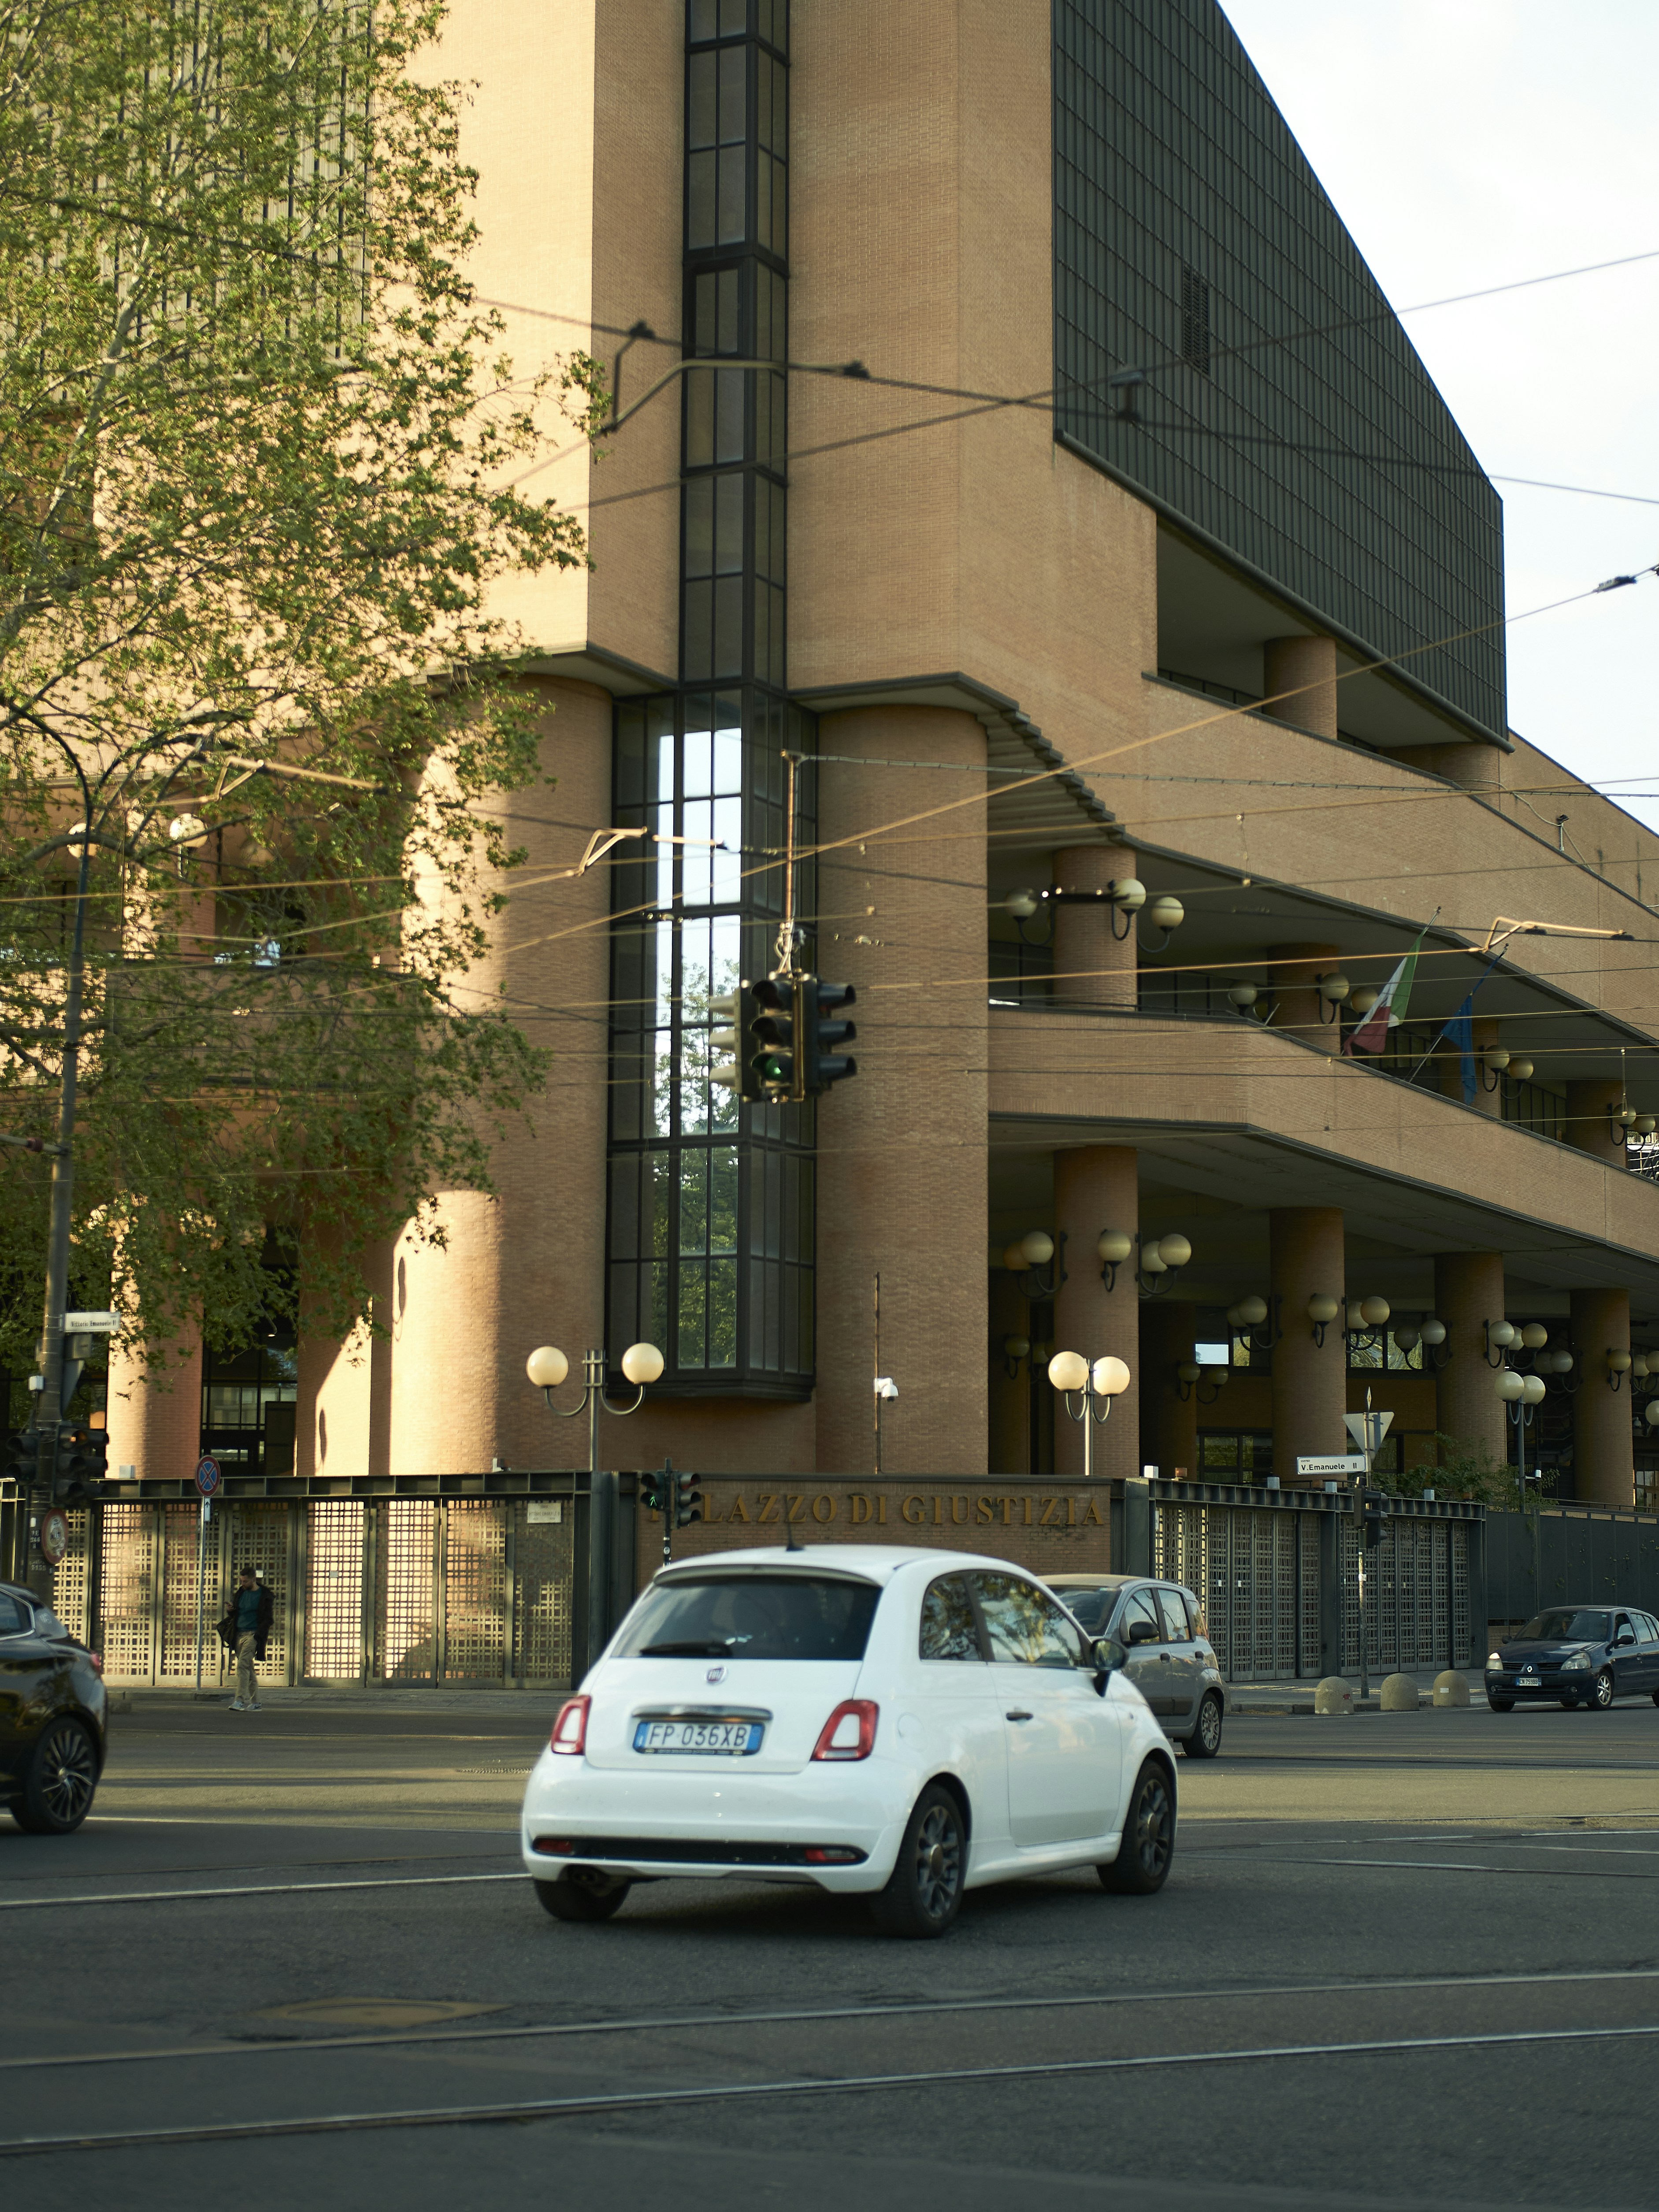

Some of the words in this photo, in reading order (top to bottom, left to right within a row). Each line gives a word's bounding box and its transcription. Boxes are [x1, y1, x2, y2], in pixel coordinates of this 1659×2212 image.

[649, 1494, 836, 1523] LAZZO
[850, 1495, 887, 1524] DI
[902, 1495, 1104, 1525] GIUSTIZIA
[649, 1726, 674, 1745] FP
[682, 1725, 747, 1746] 036XB
